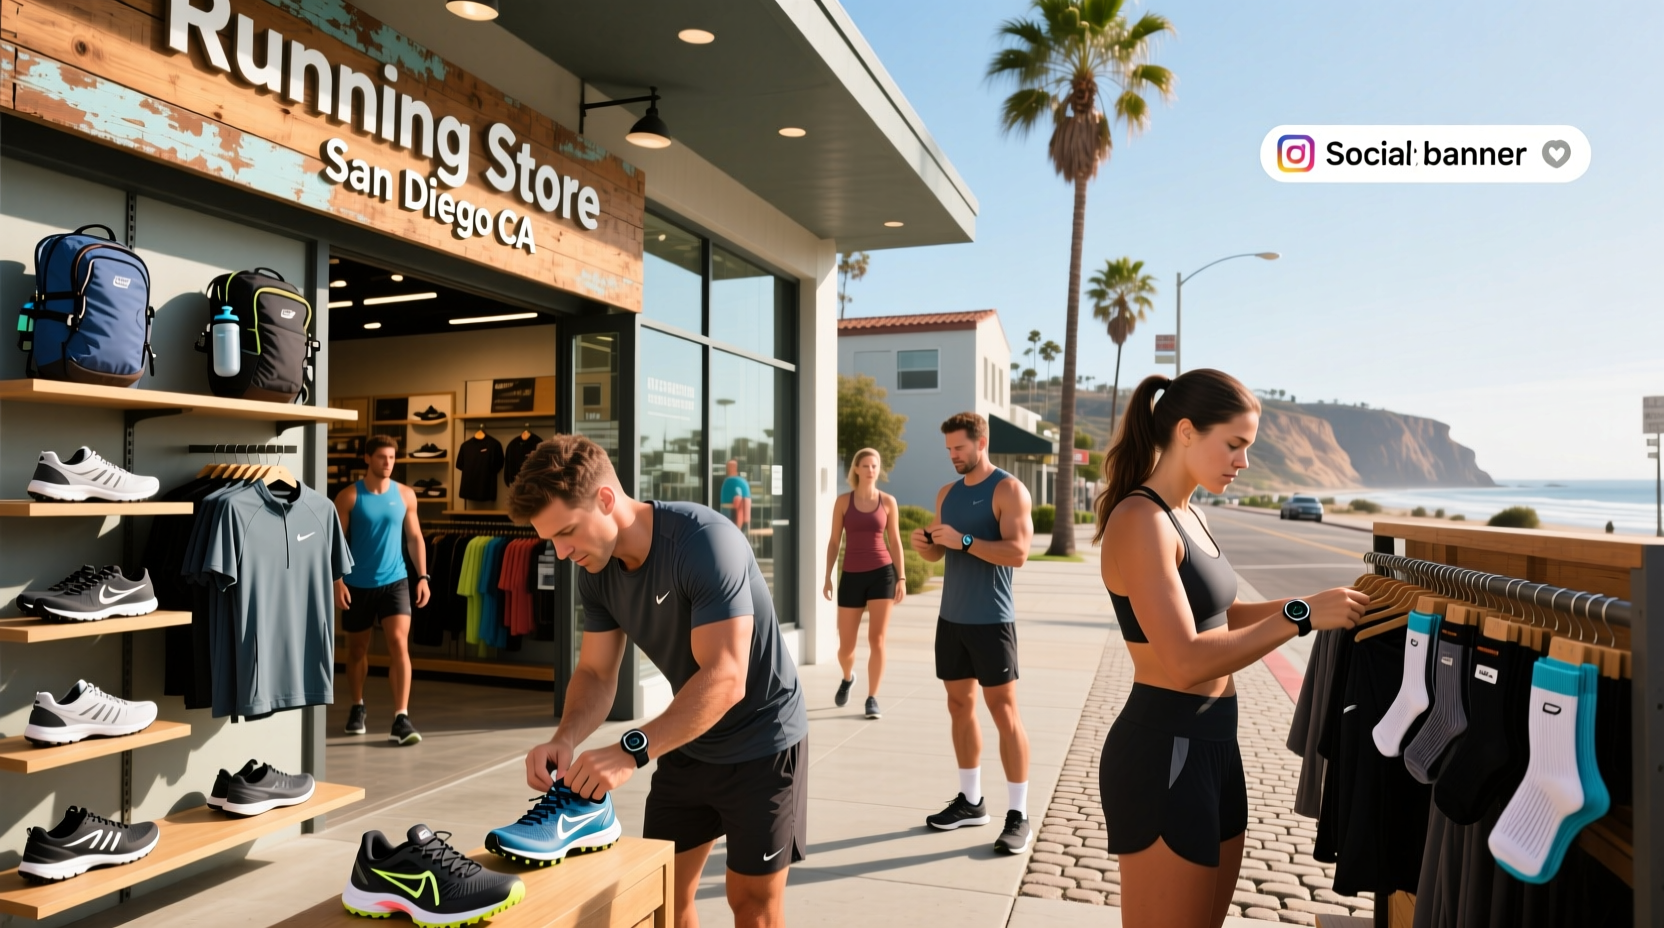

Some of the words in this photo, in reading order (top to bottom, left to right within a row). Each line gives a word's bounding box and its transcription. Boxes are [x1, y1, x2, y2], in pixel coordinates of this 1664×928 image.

[169, 0, 470, 187] Running
[485, 123, 600, 230] Store
[325, 138, 392, 200] San
[405, 169, 492, 239] Diego
[498, 209, 536, 254] CA
